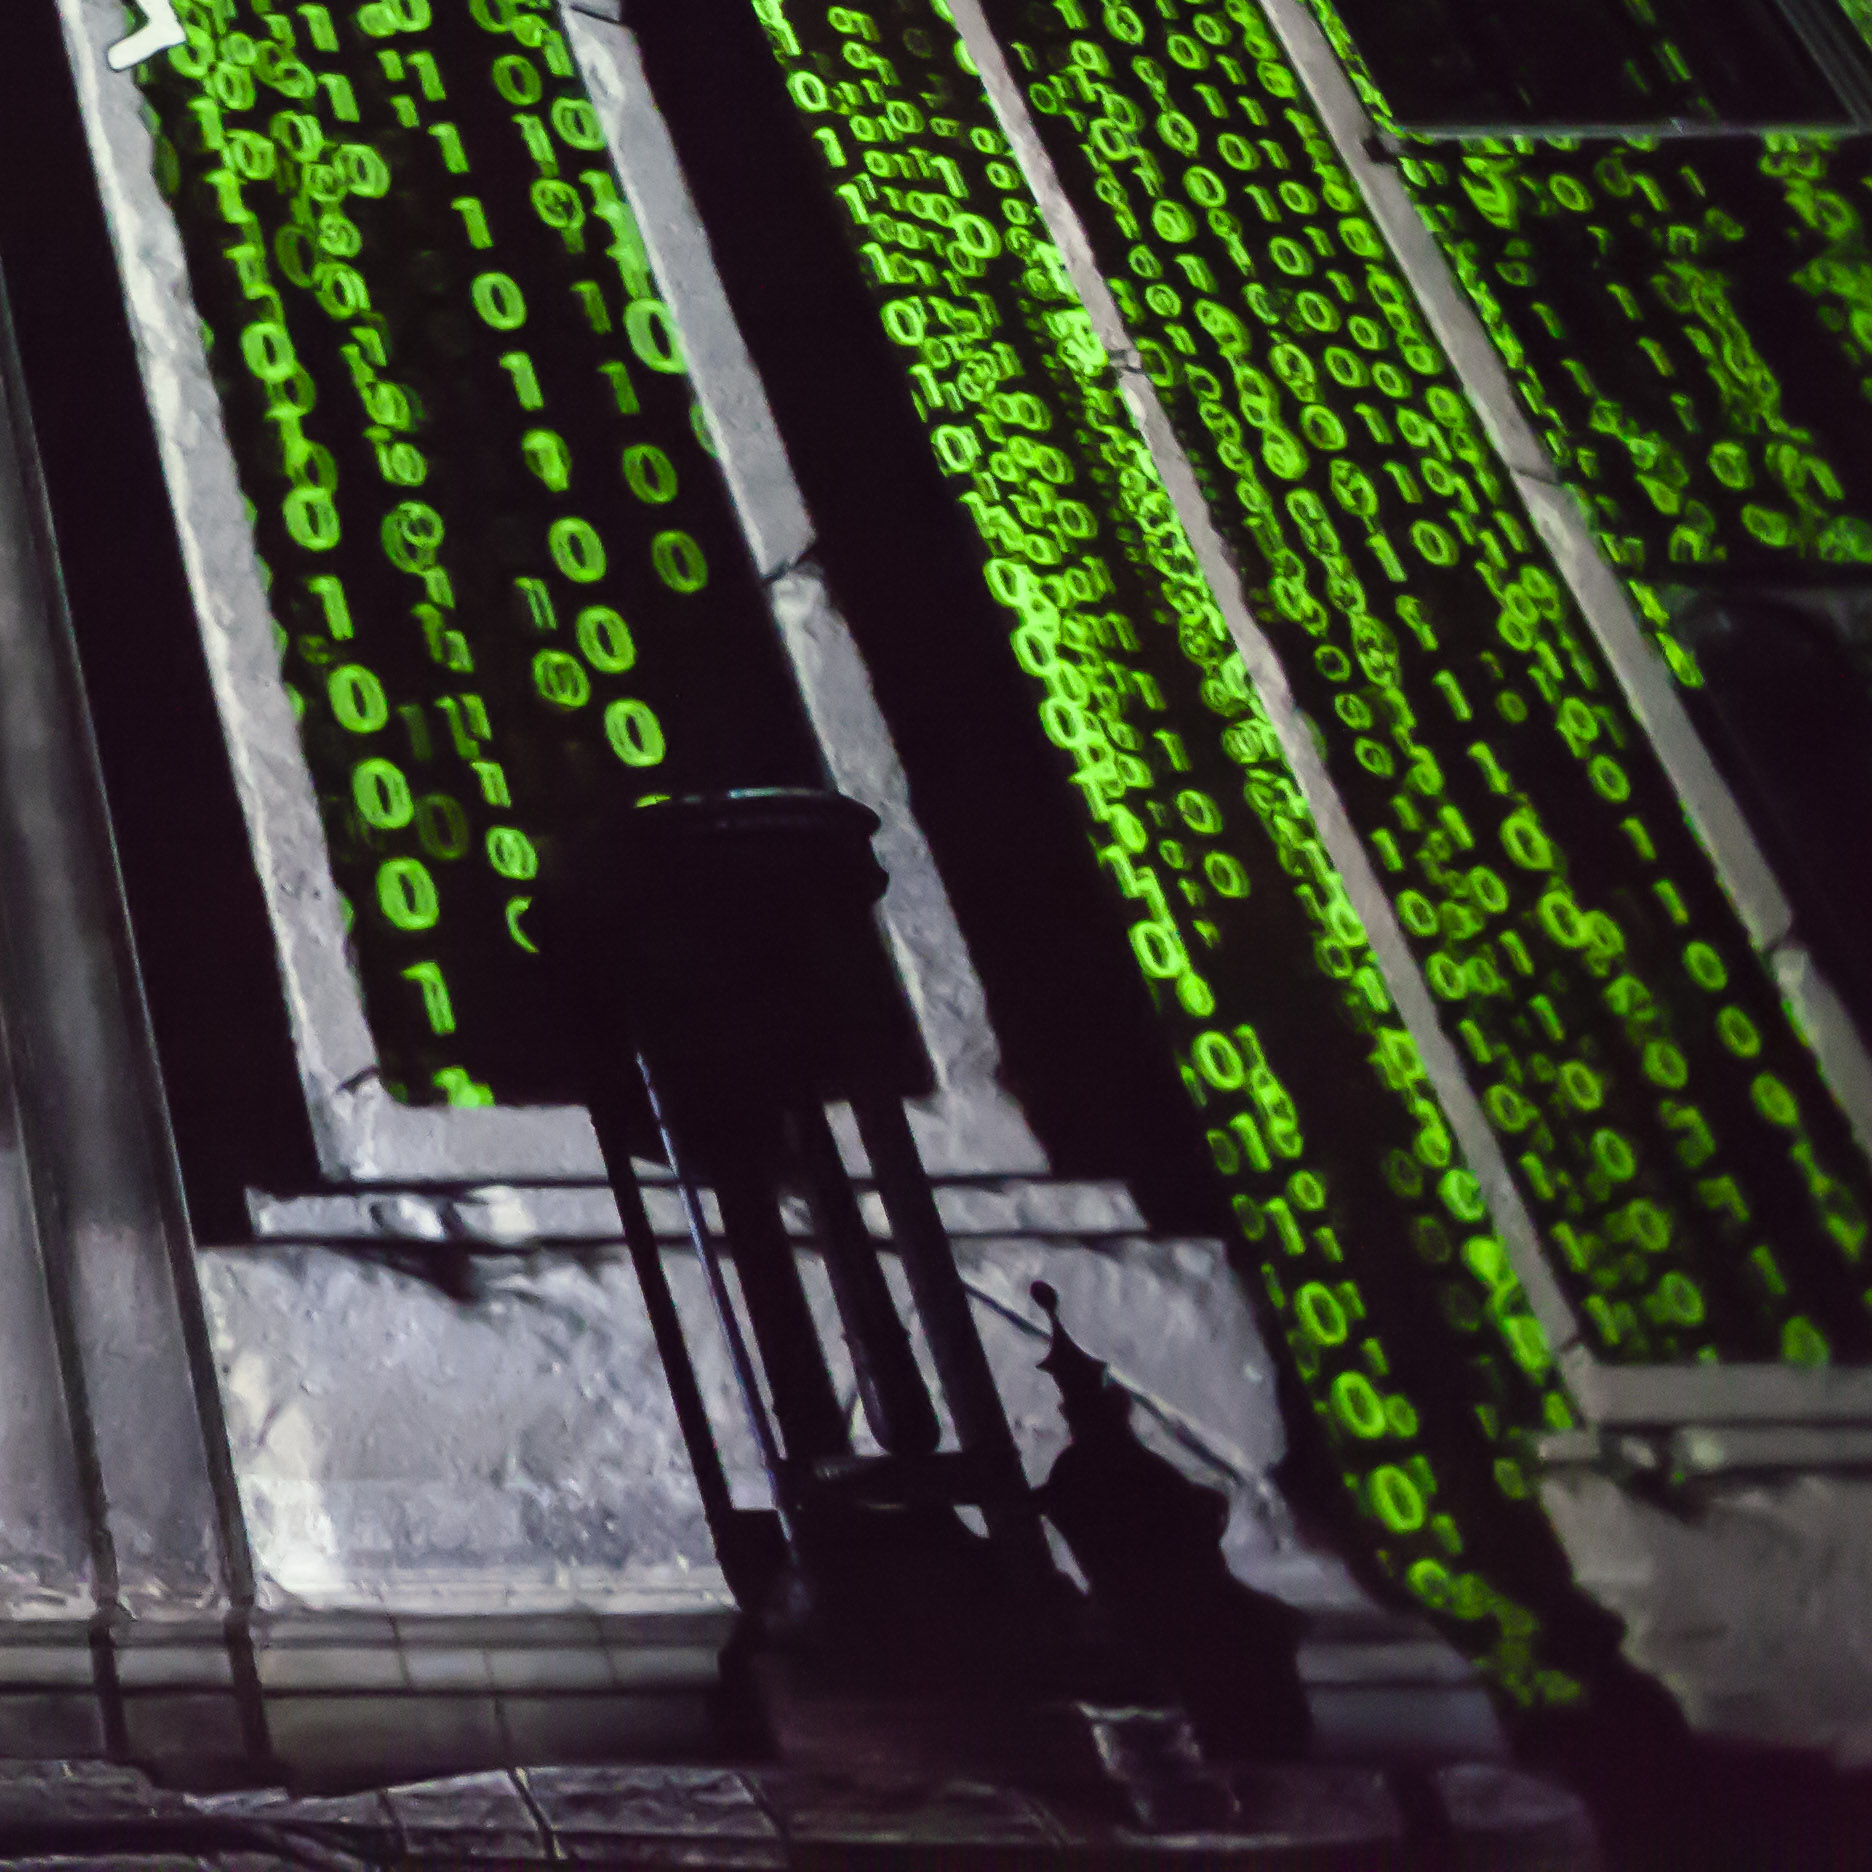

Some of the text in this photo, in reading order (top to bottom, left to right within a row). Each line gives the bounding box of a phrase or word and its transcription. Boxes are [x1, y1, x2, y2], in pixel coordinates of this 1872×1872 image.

[298, 4, 337, 51] 1
[405, 50, 446, 101] 1
[428, 123, 469, 174] 1
[452, 196, 493, 249] 1
[572, 281, 611, 333] 1
[500, 351, 544, 411] 1
[600, 361, 639, 414] 1
[1354, 404, 1391, 442] 1
[307, 575, 354, 641] 1
[402, 961, 456, 1034] 1
[1230, 1112, 1272, 1171] 1
